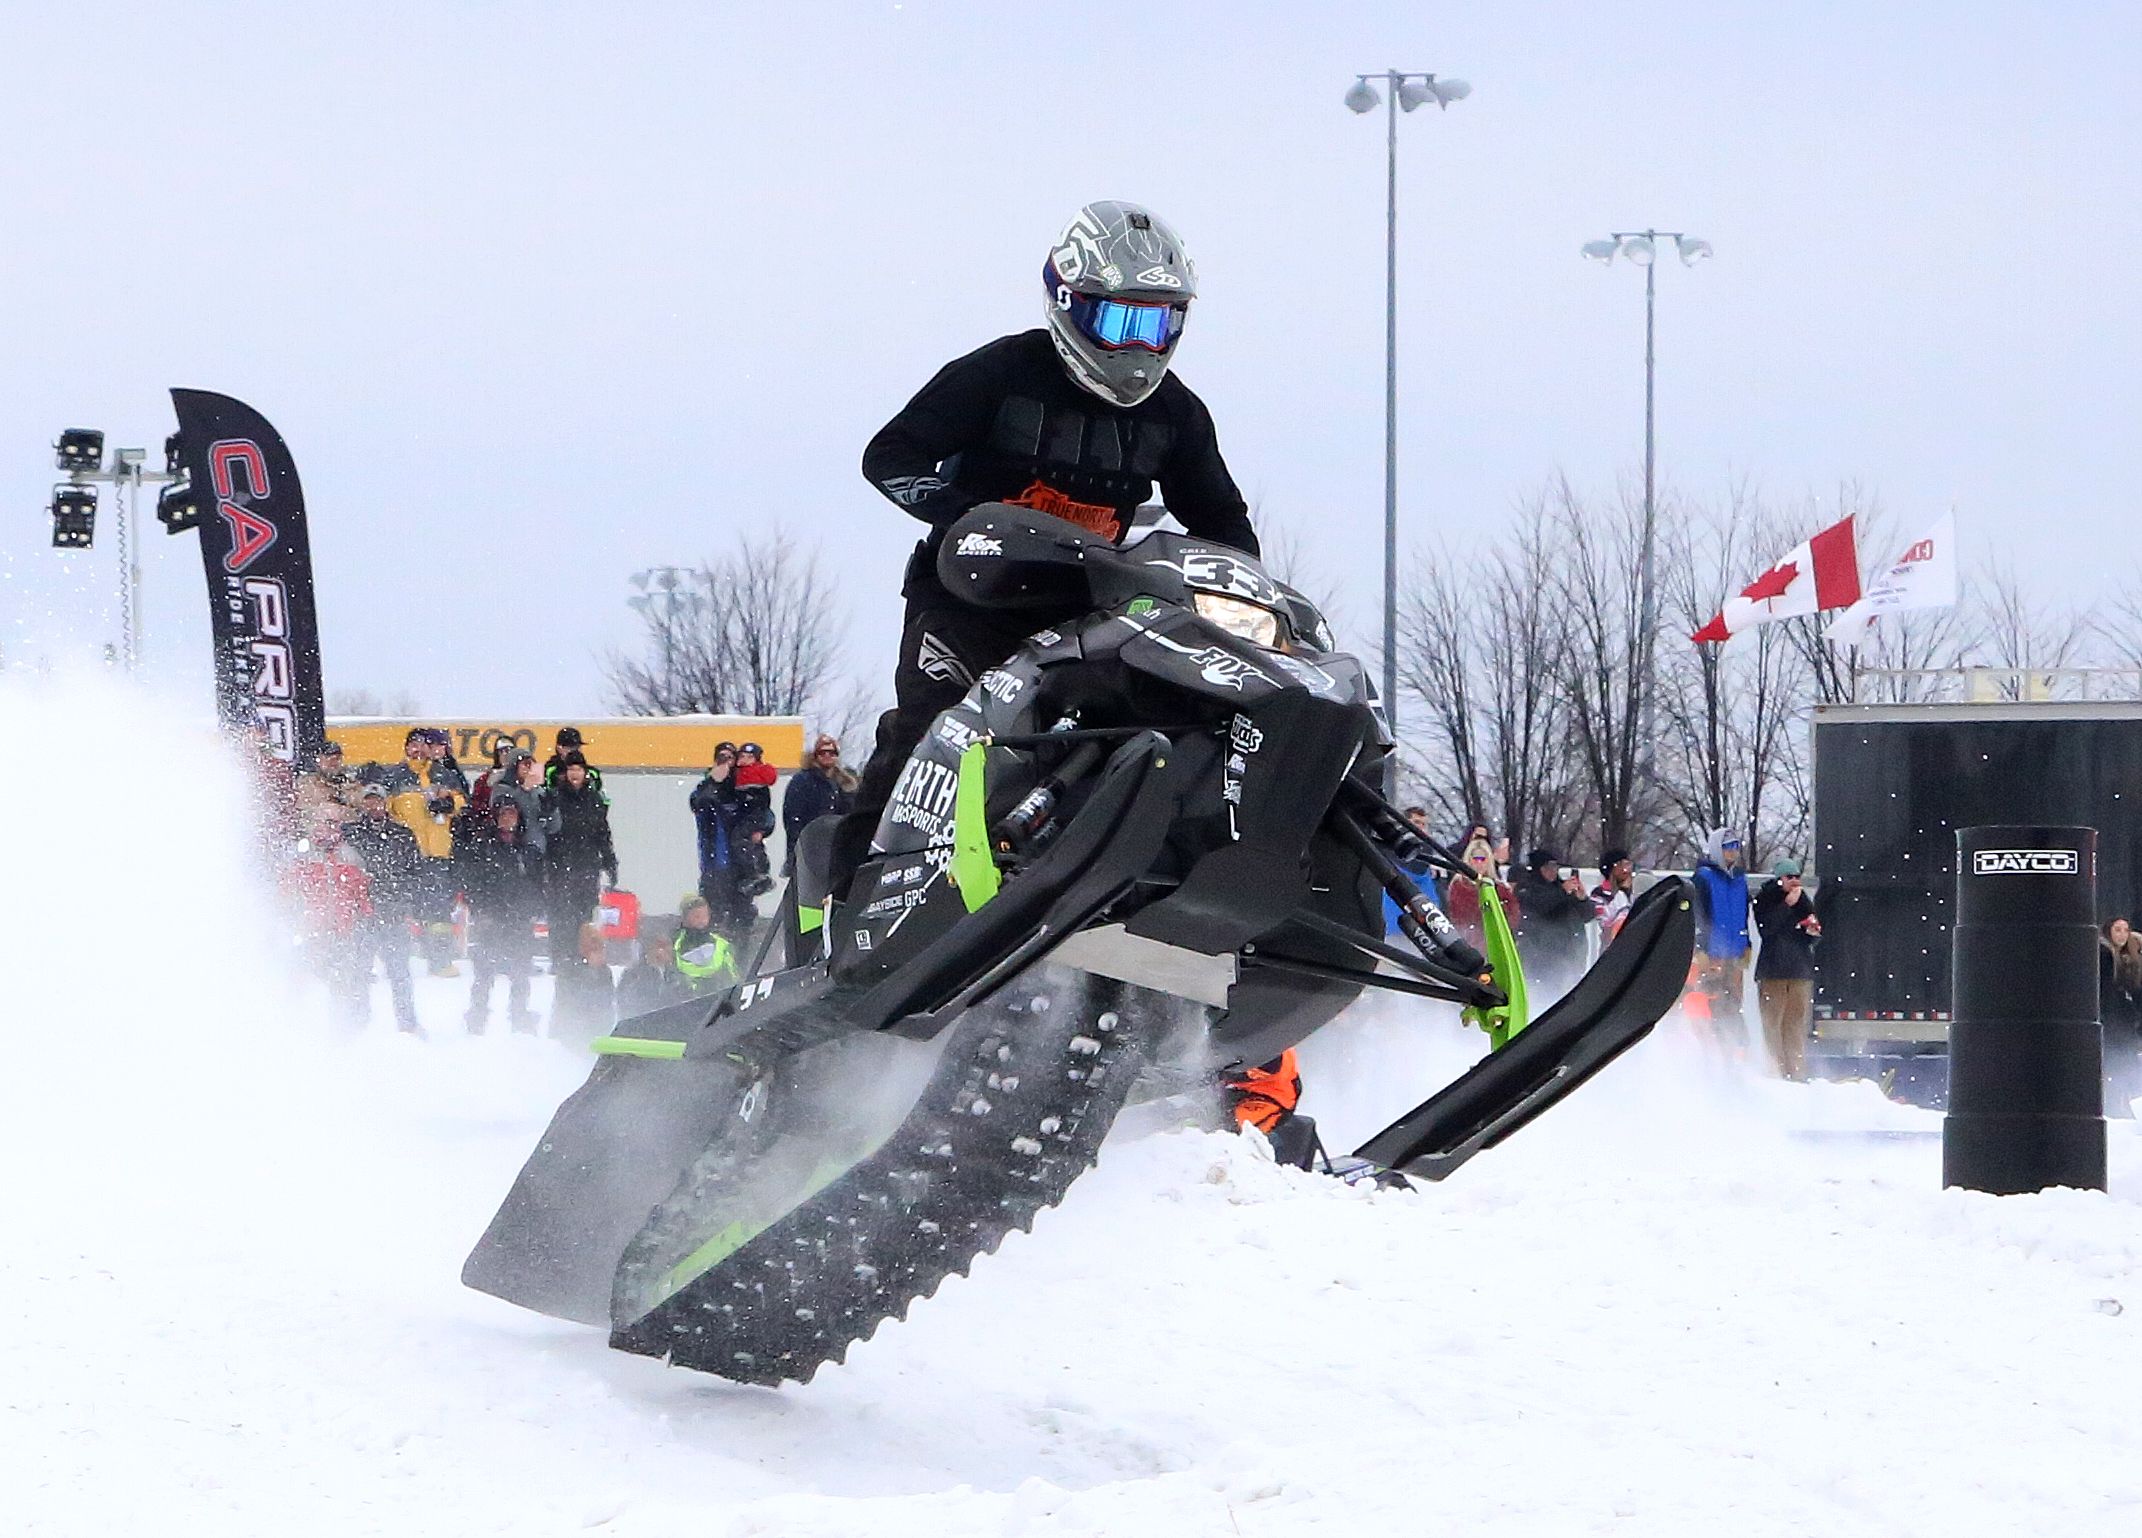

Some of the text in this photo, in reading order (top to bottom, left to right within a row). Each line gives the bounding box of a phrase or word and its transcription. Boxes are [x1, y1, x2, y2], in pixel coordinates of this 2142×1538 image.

[1187, 557, 1273, 601] 33
[1190, 646, 1262, 680] FOX
[890, 757, 958, 817] ERTH
[1979, 853, 2070, 871] DAYCO
[904, 888, 927, 908] GPC
